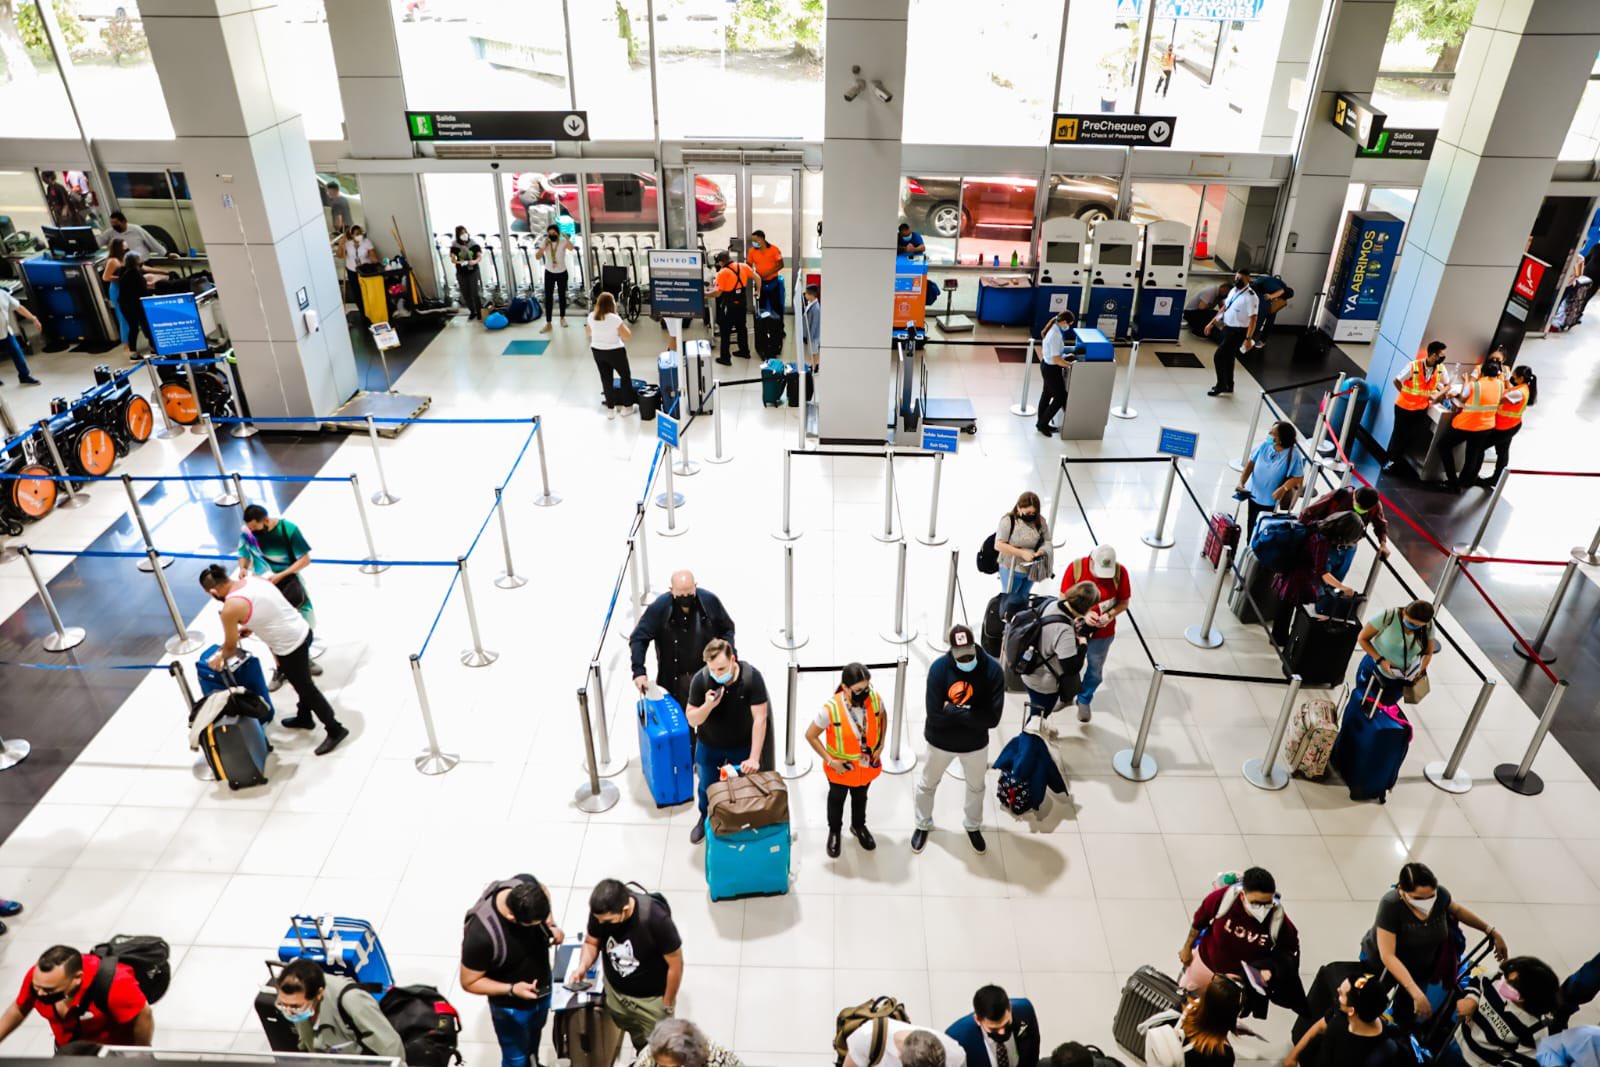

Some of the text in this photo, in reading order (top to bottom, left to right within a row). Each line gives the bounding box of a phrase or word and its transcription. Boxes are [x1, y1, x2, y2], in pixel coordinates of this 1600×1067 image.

[1082, 120, 1147, 132] PreChequeo
[1393, 132, 1414, 140] Salida
[1351, 230, 1376, 292] ABRIMOS
[1344, 293, 1359, 313] YA
[1224, 919, 1269, 946] LOVE
